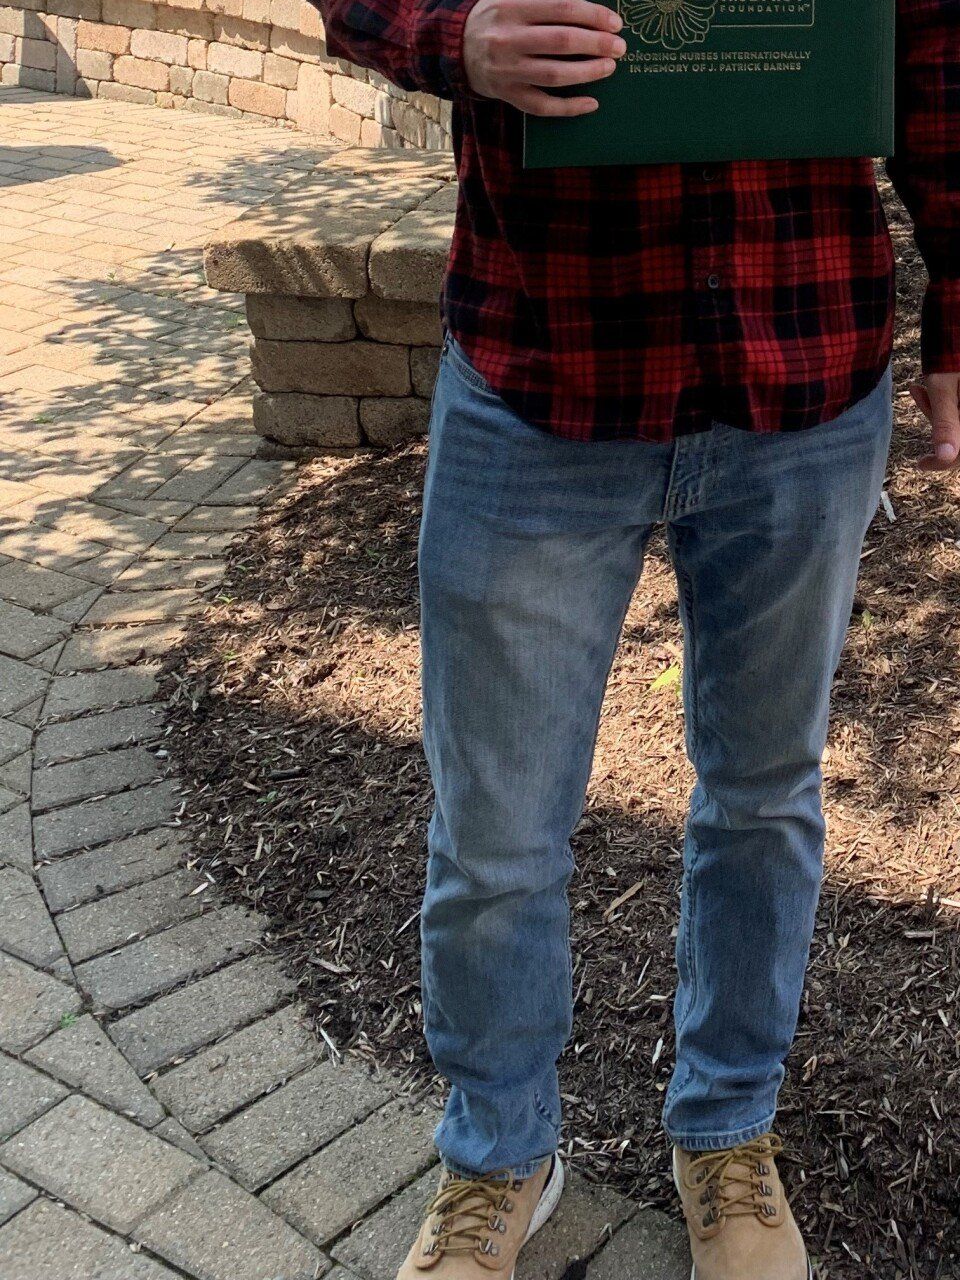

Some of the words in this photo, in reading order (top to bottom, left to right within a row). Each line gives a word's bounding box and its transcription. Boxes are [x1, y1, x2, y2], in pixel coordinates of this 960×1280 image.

[679, 51, 719, 61] NURSES
[720, 50, 811, 60] INTERNATIONALLY
[629, 64, 641, 73] IN
[643, 63, 688, 73] MEMORY
[691, 63, 706, 72] OF
[708, 63, 717, 72] J.
[719, 62, 761, 72] PATRICK
[763, 62, 802, 71] BARNES
